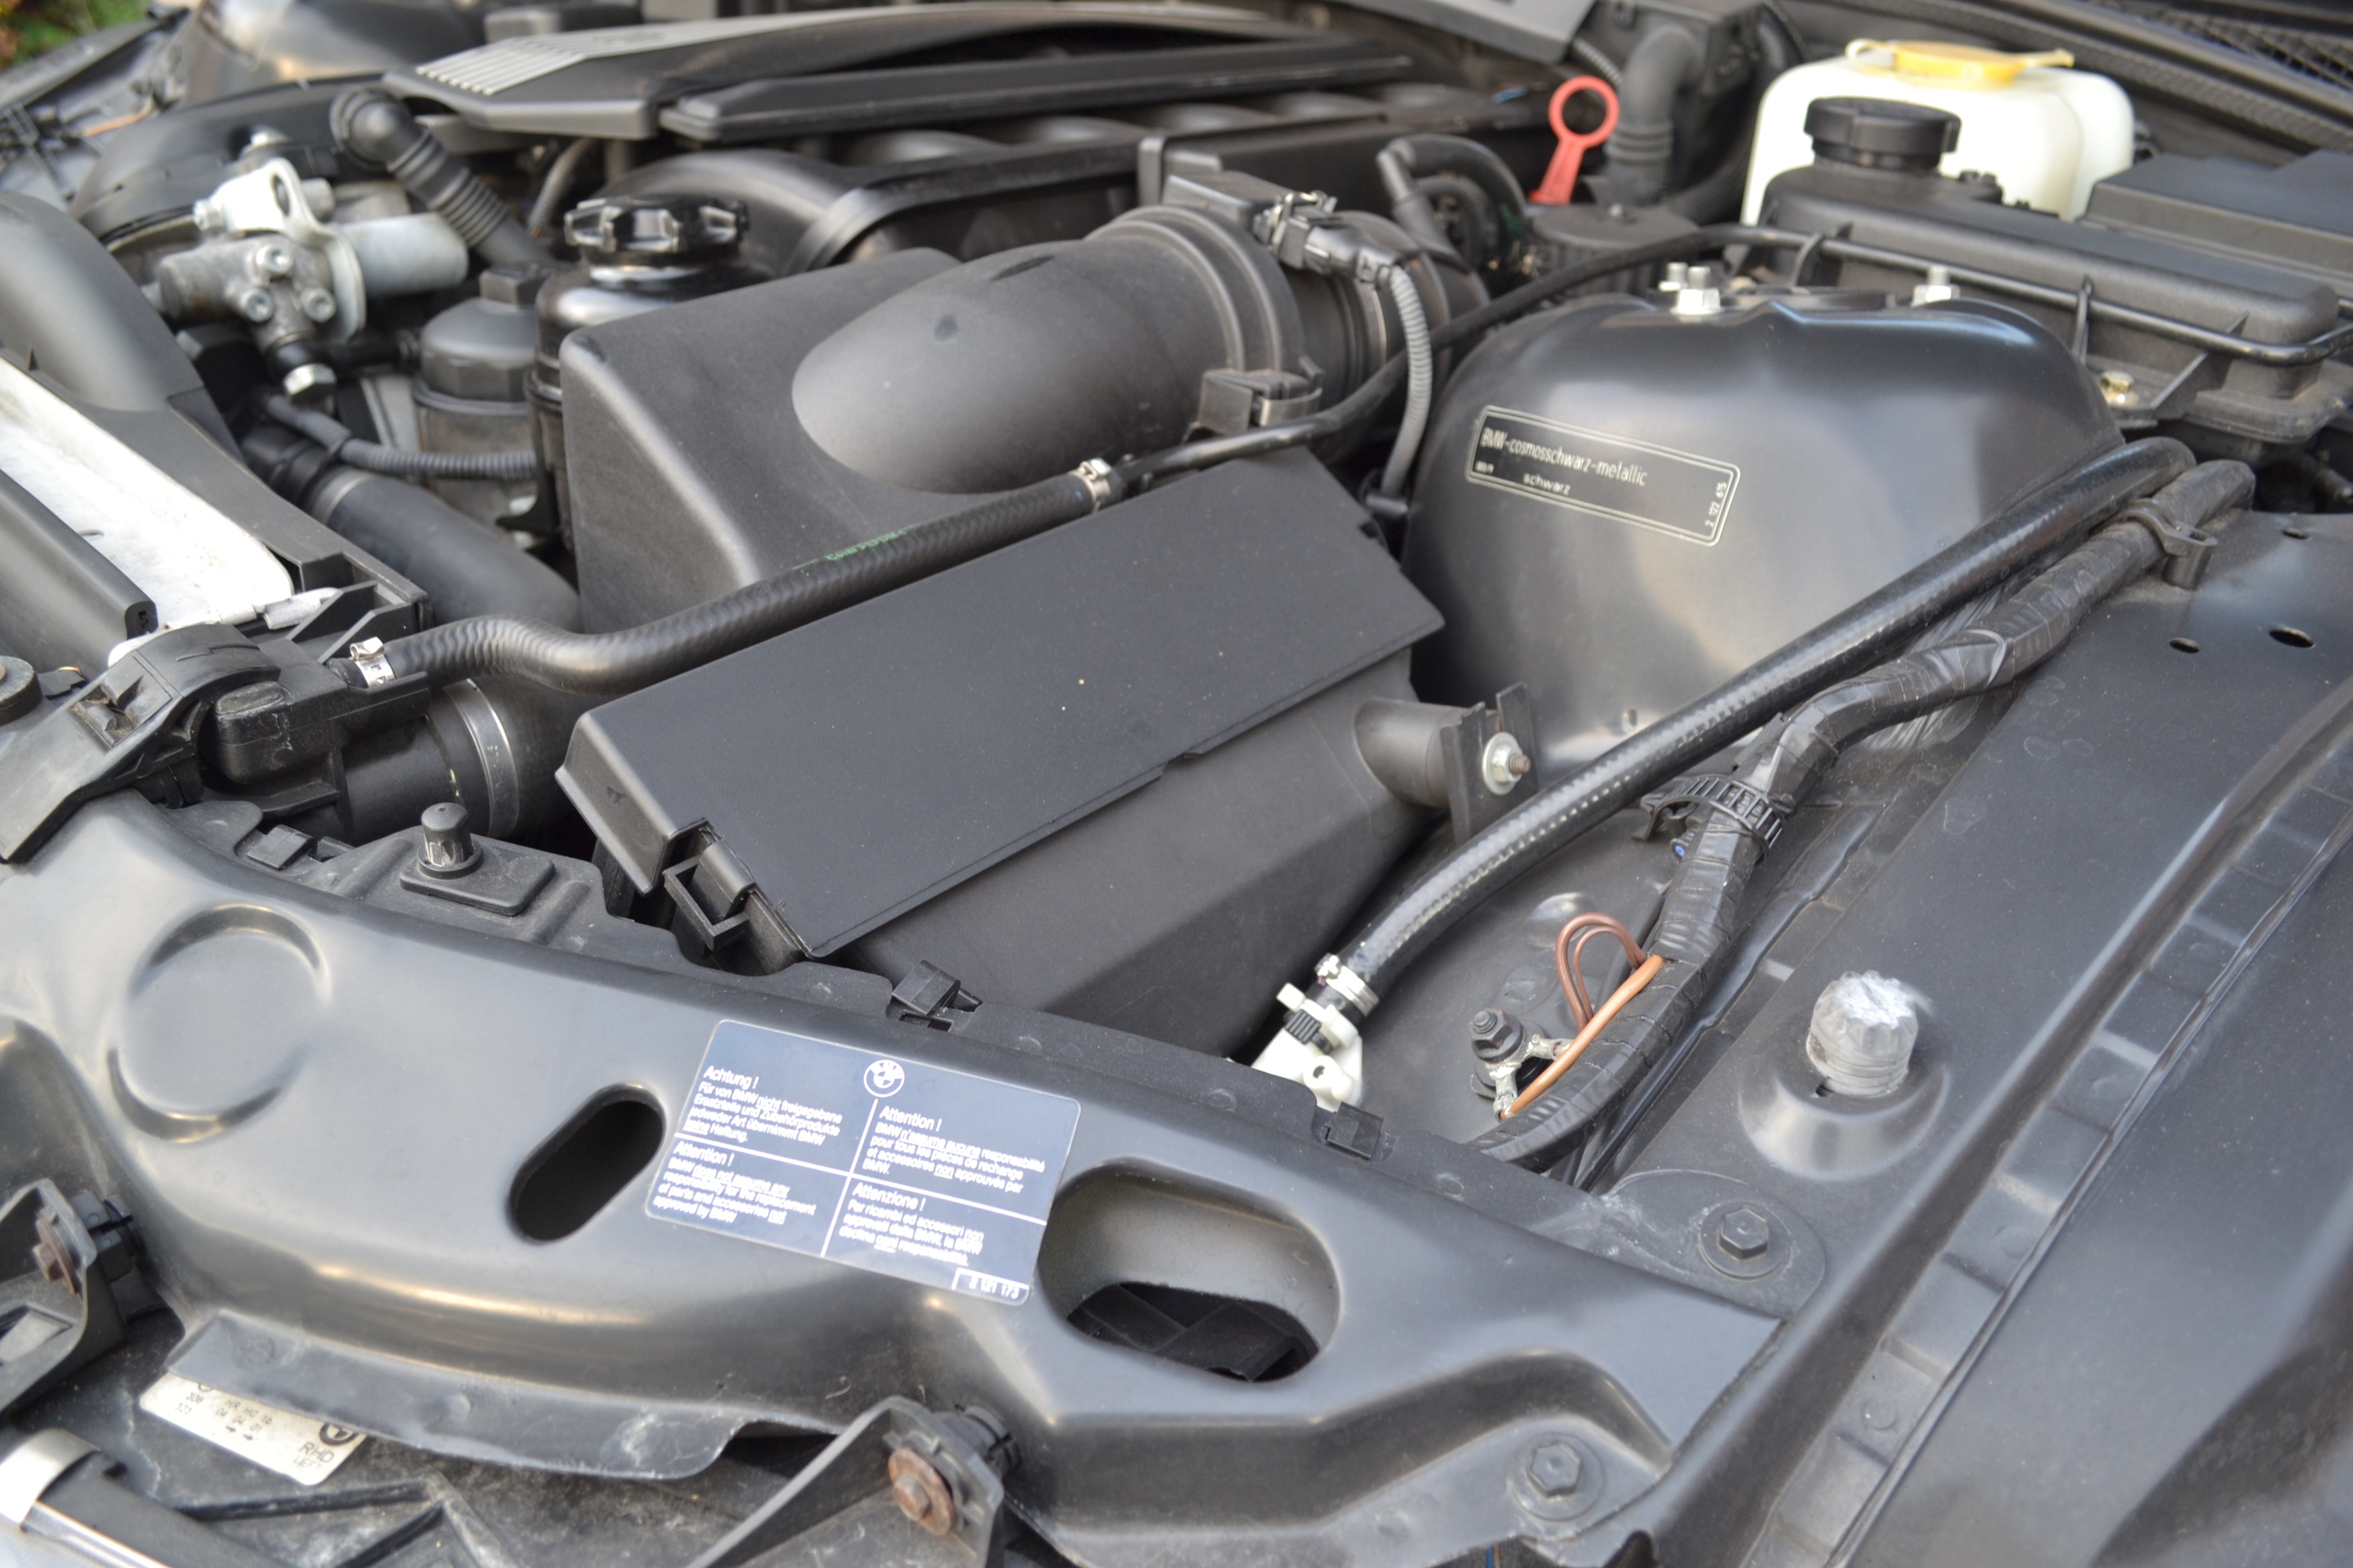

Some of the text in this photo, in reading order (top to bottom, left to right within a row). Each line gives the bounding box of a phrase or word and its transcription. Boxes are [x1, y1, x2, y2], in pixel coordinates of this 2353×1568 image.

[1523, 473, 1570, 495] schwarz
[703, 1066, 758, 1089] Achtung !
[694, 1094, 839, 1135] Ersatzteile und Zubehörprodukte
[699, 1081, 842, 1124] Für von BMW nicht freigegebene
[688, 1106, 825, 1145] jedweder Art übernimmt BMW
[879, 1106, 941, 1131] Attention !
[710, 1123, 746, 1142] Haftung.
[674, 1141, 733, 1165] Attention !
[870, 1136, 1023, 1180] pour tous les pièces de rechange
[875, 1122, 1044, 1171] BMW n'assume aucune responsabilité
[668, 1157, 694, 1172] BMW
[863, 1158, 889, 1173] BMW.
[867, 1148, 1023, 1192] et accessoires non approuvés par
[658, 1183, 670, 1193] of
[725, 1184, 738, 1196] for
[852, 1182, 925, 1210] Attenzione !
[709, 1207, 736, 1223] BMW
[848, 1199, 984, 1243] Per ricambi ed accessori non
[914, 1228, 942, 1246] BMW,
[954, 1238, 982, 1254] BMW
[293, 1454, 323, 1470] LEFT
[299, 1441, 335, 1464] RHD
